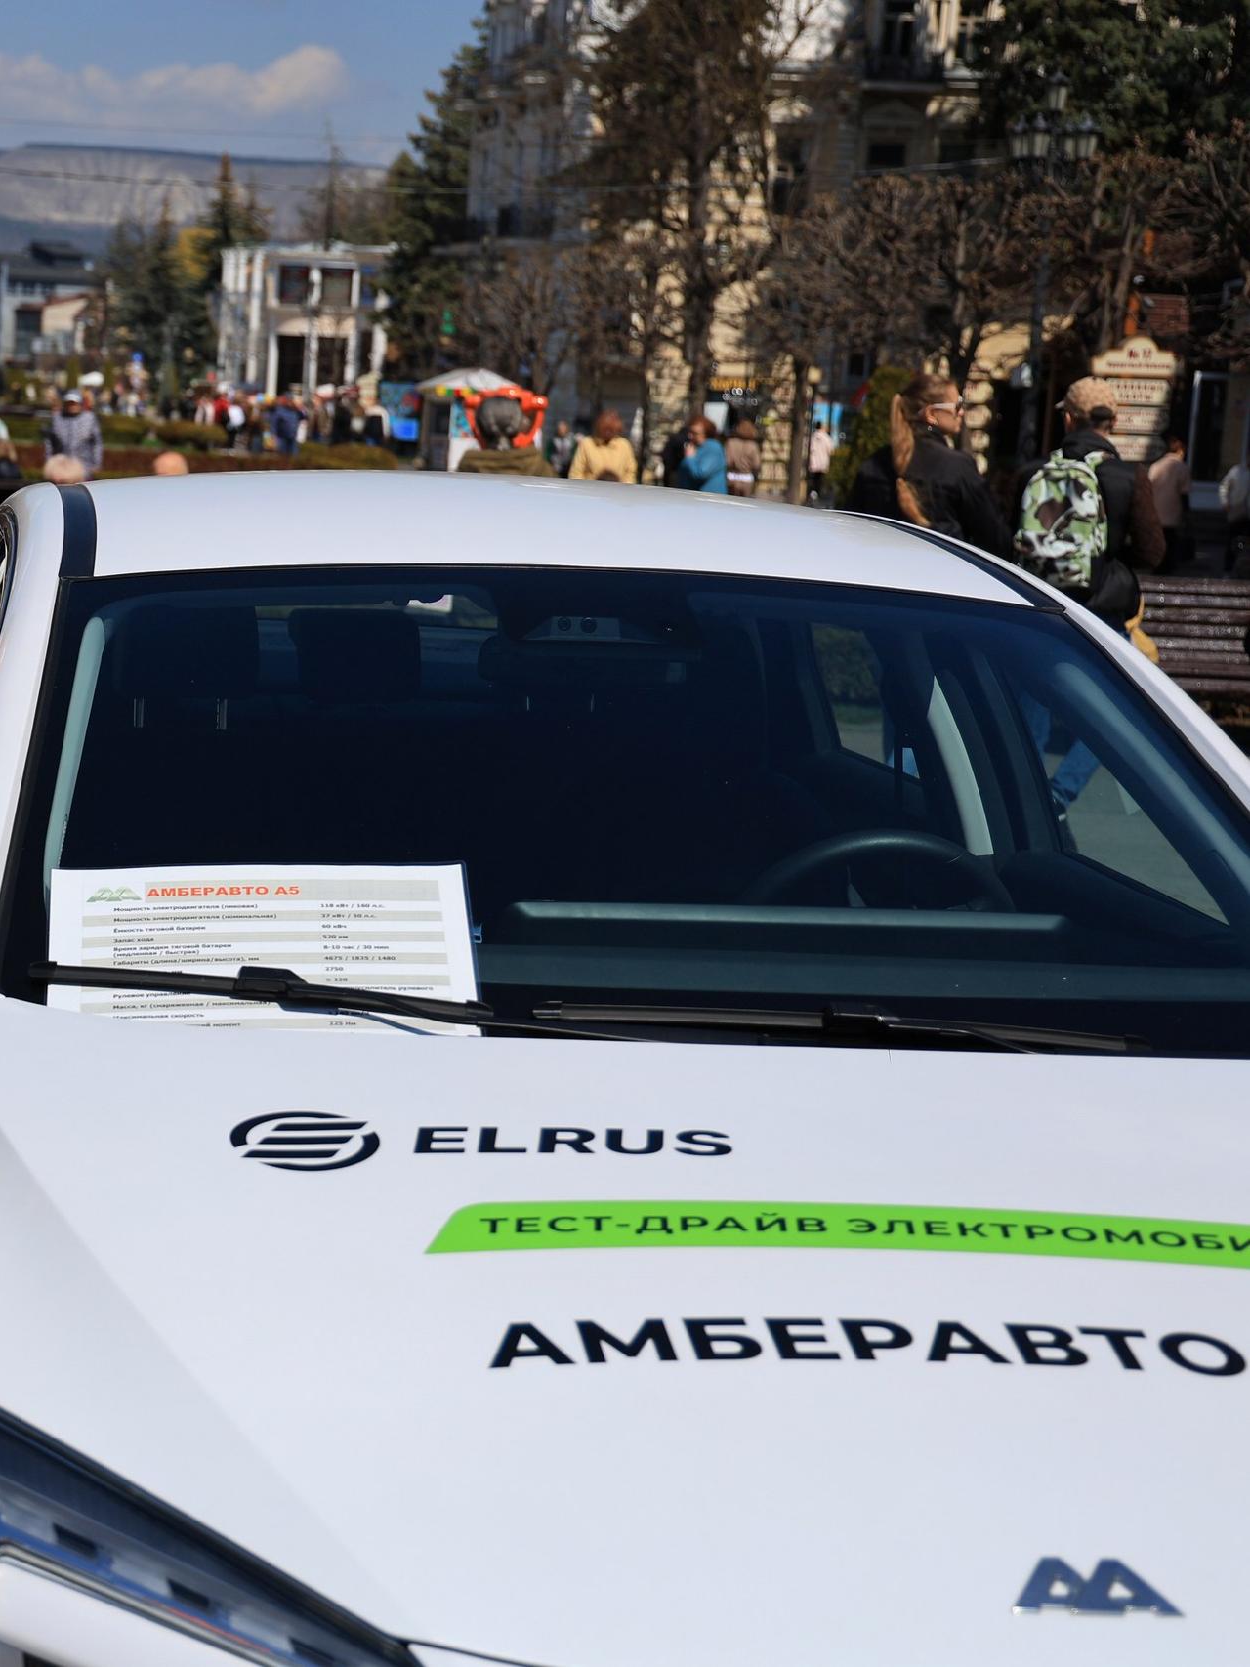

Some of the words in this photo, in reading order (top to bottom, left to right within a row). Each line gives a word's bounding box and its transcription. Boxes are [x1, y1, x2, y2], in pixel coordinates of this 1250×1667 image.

[147, 886, 269, 897] АМБЕРАВТО
[113, 951, 157, 959] (медленная
[413, 1126, 733, 1156] ELRUS
[480, 1213, 828, 1235] ТЕСТ-ДРАЙВ
[488, 1317, 1247, 1377] АМБЕРАВТО
